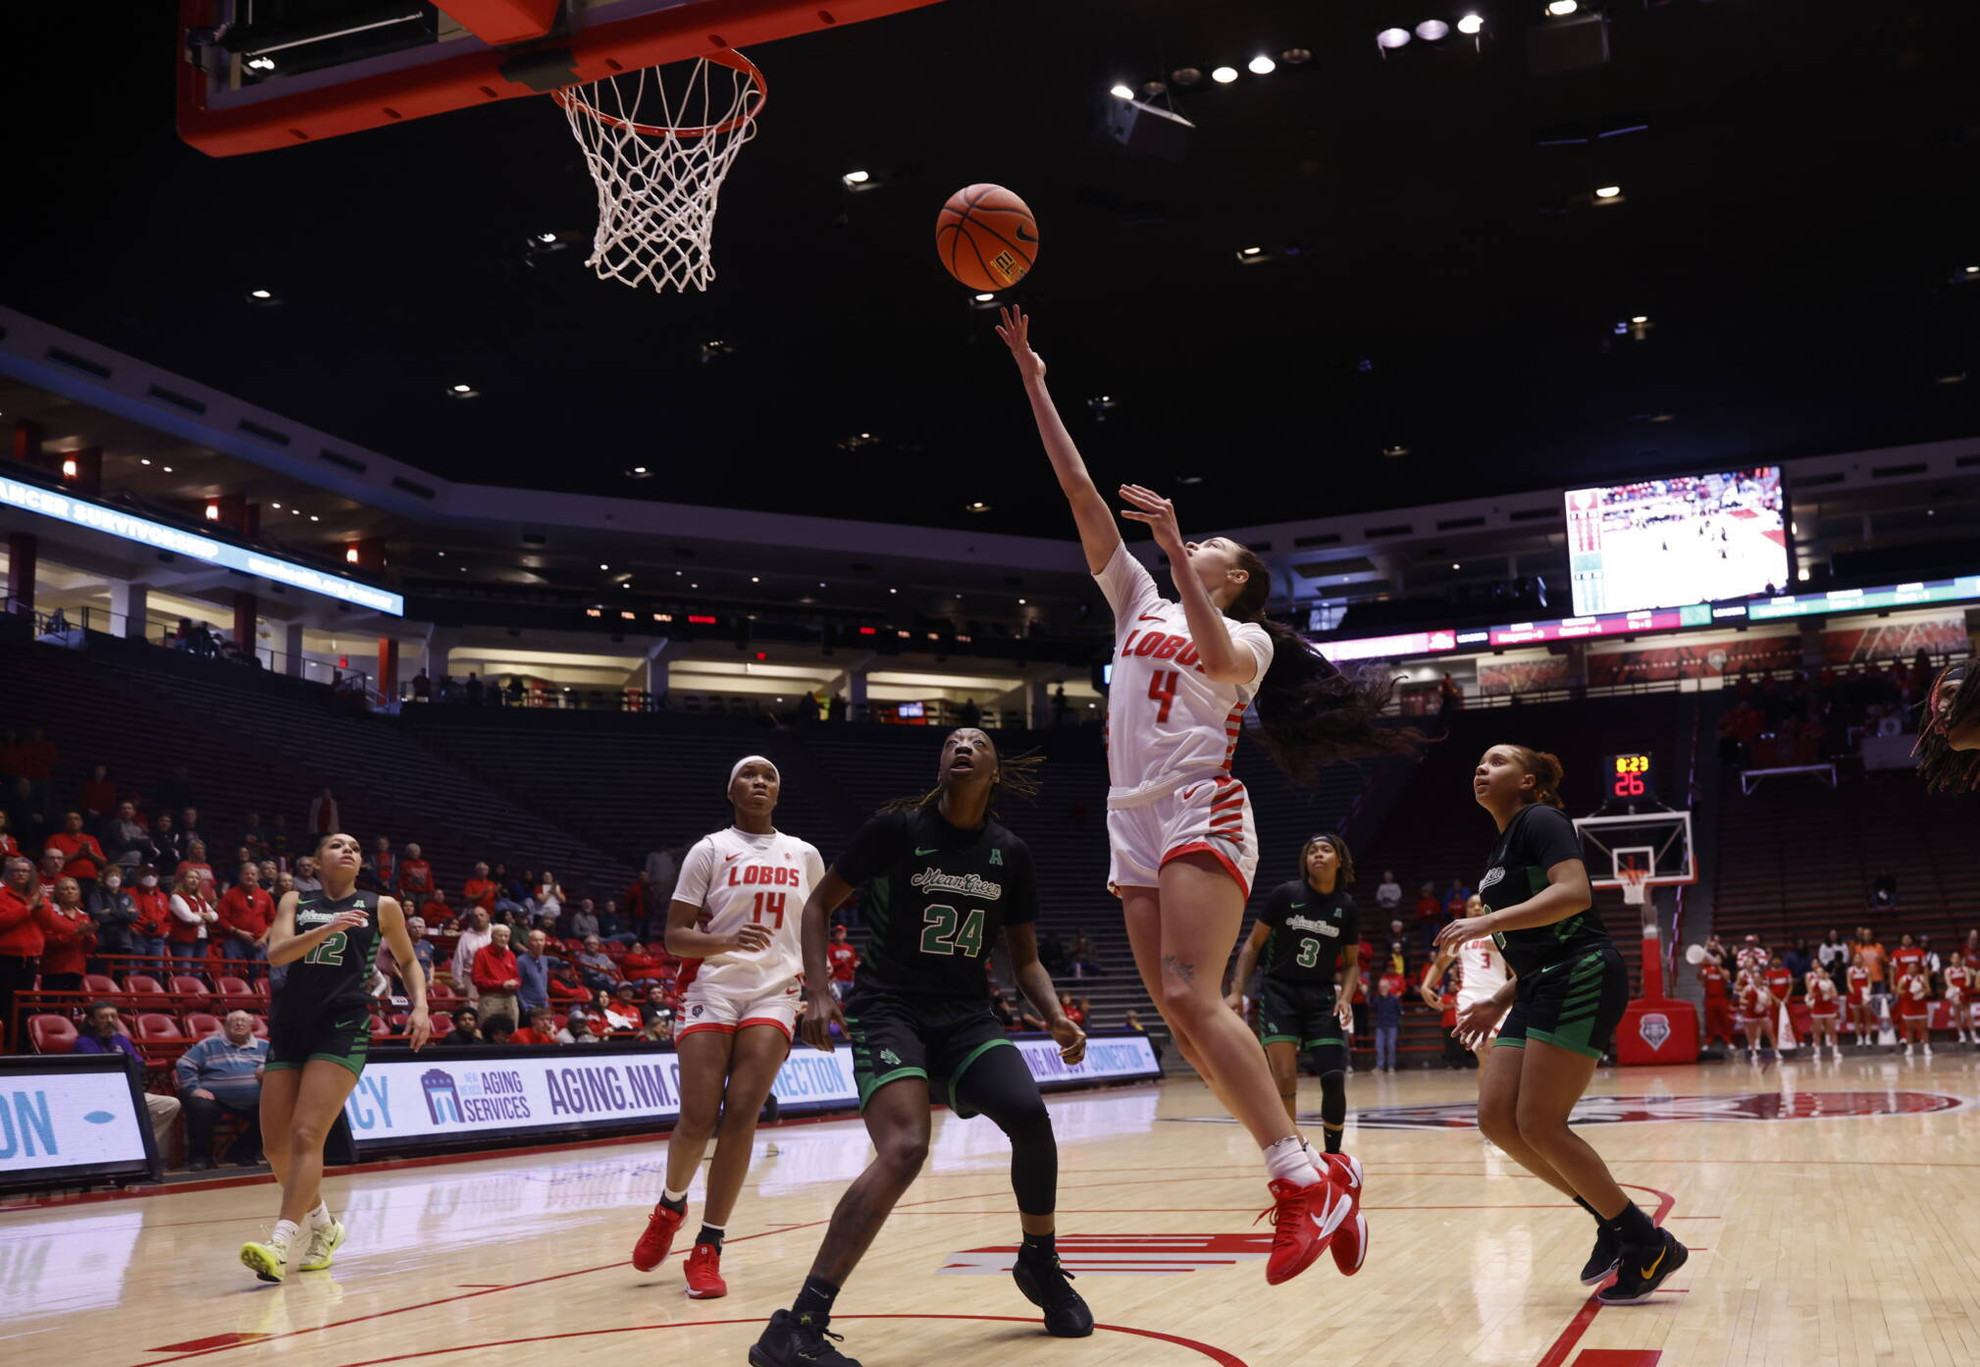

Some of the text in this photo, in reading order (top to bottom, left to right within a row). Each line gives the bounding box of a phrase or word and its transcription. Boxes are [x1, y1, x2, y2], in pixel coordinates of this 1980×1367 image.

[1121, 629, 1206, 674] LOBO
[1148, 669, 1180, 723] 4
[1615, 771, 1645, 796] 26
[728, 865, 800, 888] LOBOS
[753, 891, 786, 930] 14
[920, 903, 985, 958] 24
[1296, 937, 1320, 968] 3
[1481, 953, 1491, 969] 3
[481, 1071, 523, 1095] AGING
[349, 1075, 393, 1131] CY
[463, 1095, 531, 1123] SERVICES
